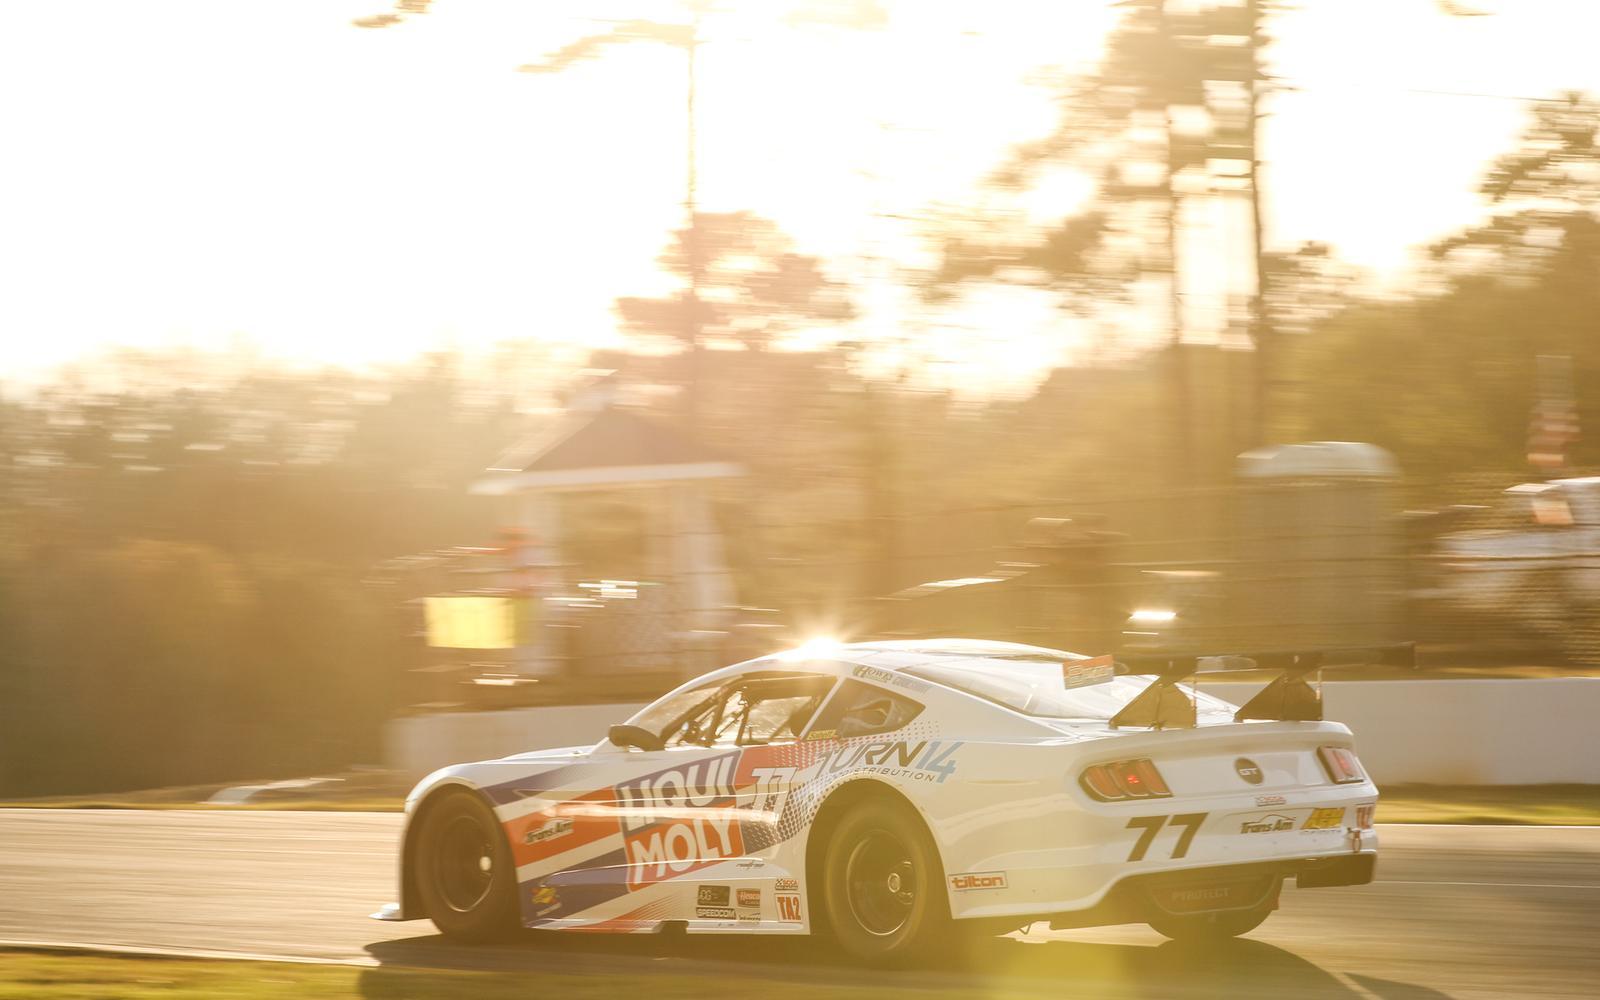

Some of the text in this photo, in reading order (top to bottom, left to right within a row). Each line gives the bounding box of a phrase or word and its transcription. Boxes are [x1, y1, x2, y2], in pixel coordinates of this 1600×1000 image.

[620, 755, 734, 831] LIQUI
[631, 814, 734, 884] MOLY
[1125, 812, 1209, 863] 77
[952, 876, 1004, 888] tilton
[697, 908, 736, 919] SPEEDCOM
[777, 896, 802, 921] TA2
